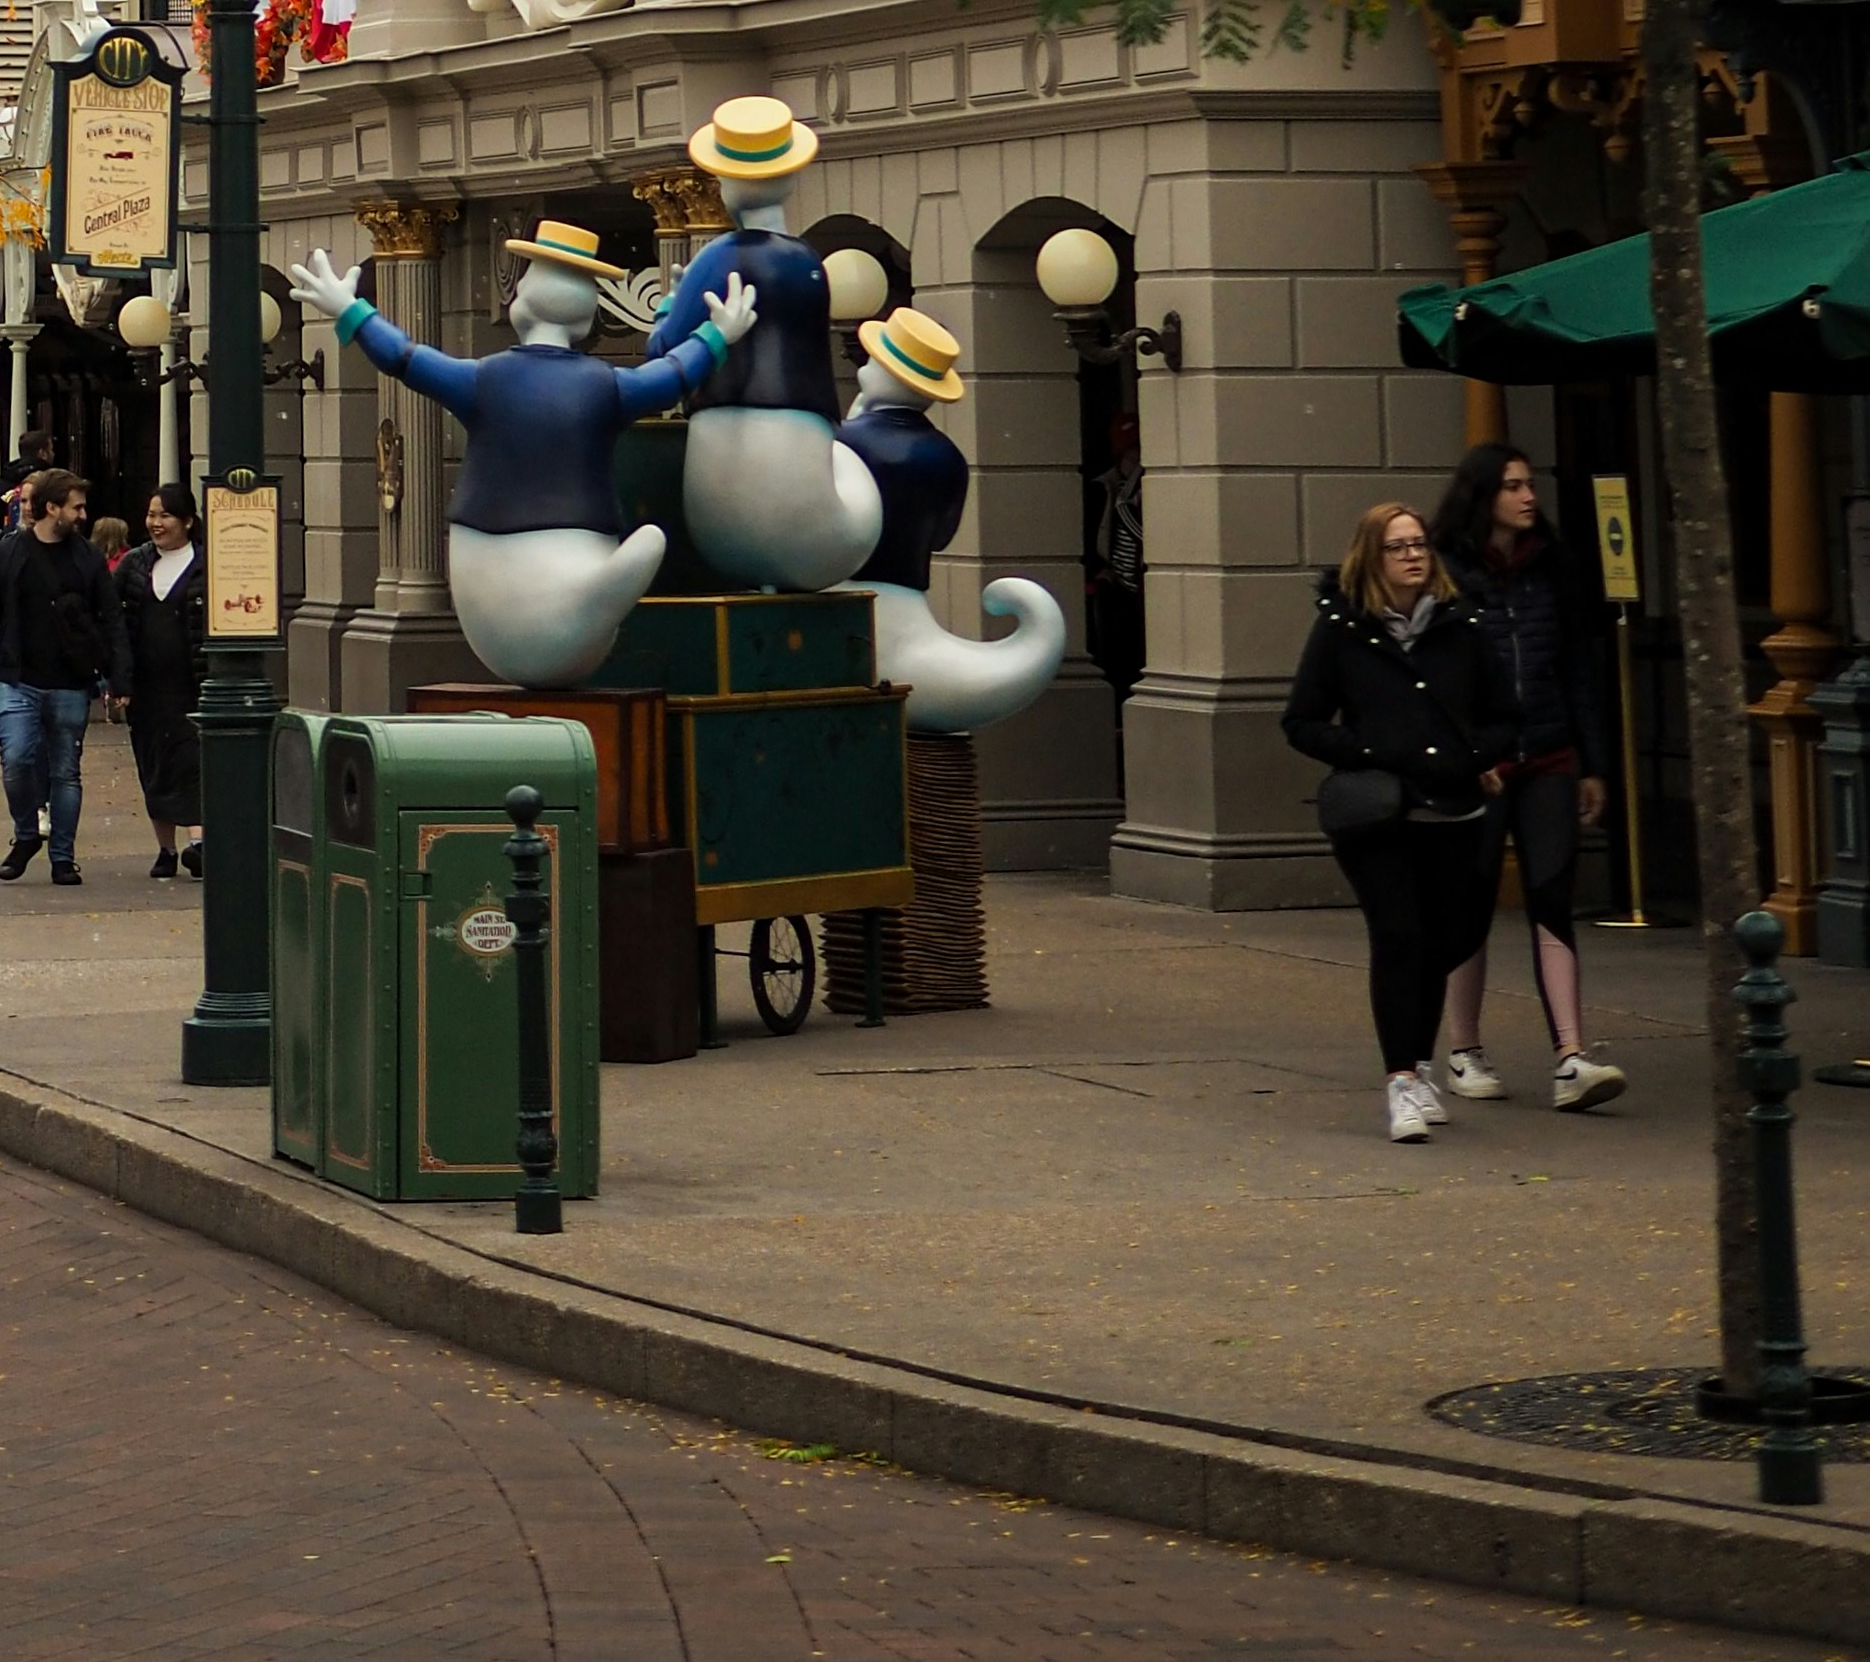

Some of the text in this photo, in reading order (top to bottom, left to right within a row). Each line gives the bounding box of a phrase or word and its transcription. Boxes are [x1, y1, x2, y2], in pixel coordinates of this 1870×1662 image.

[98, 37, 149, 80] CITY
[133, 83, 169, 111] STOP
[84, 195, 151, 234] Central Plaza
[473, 914, 493, 924] MAIN
